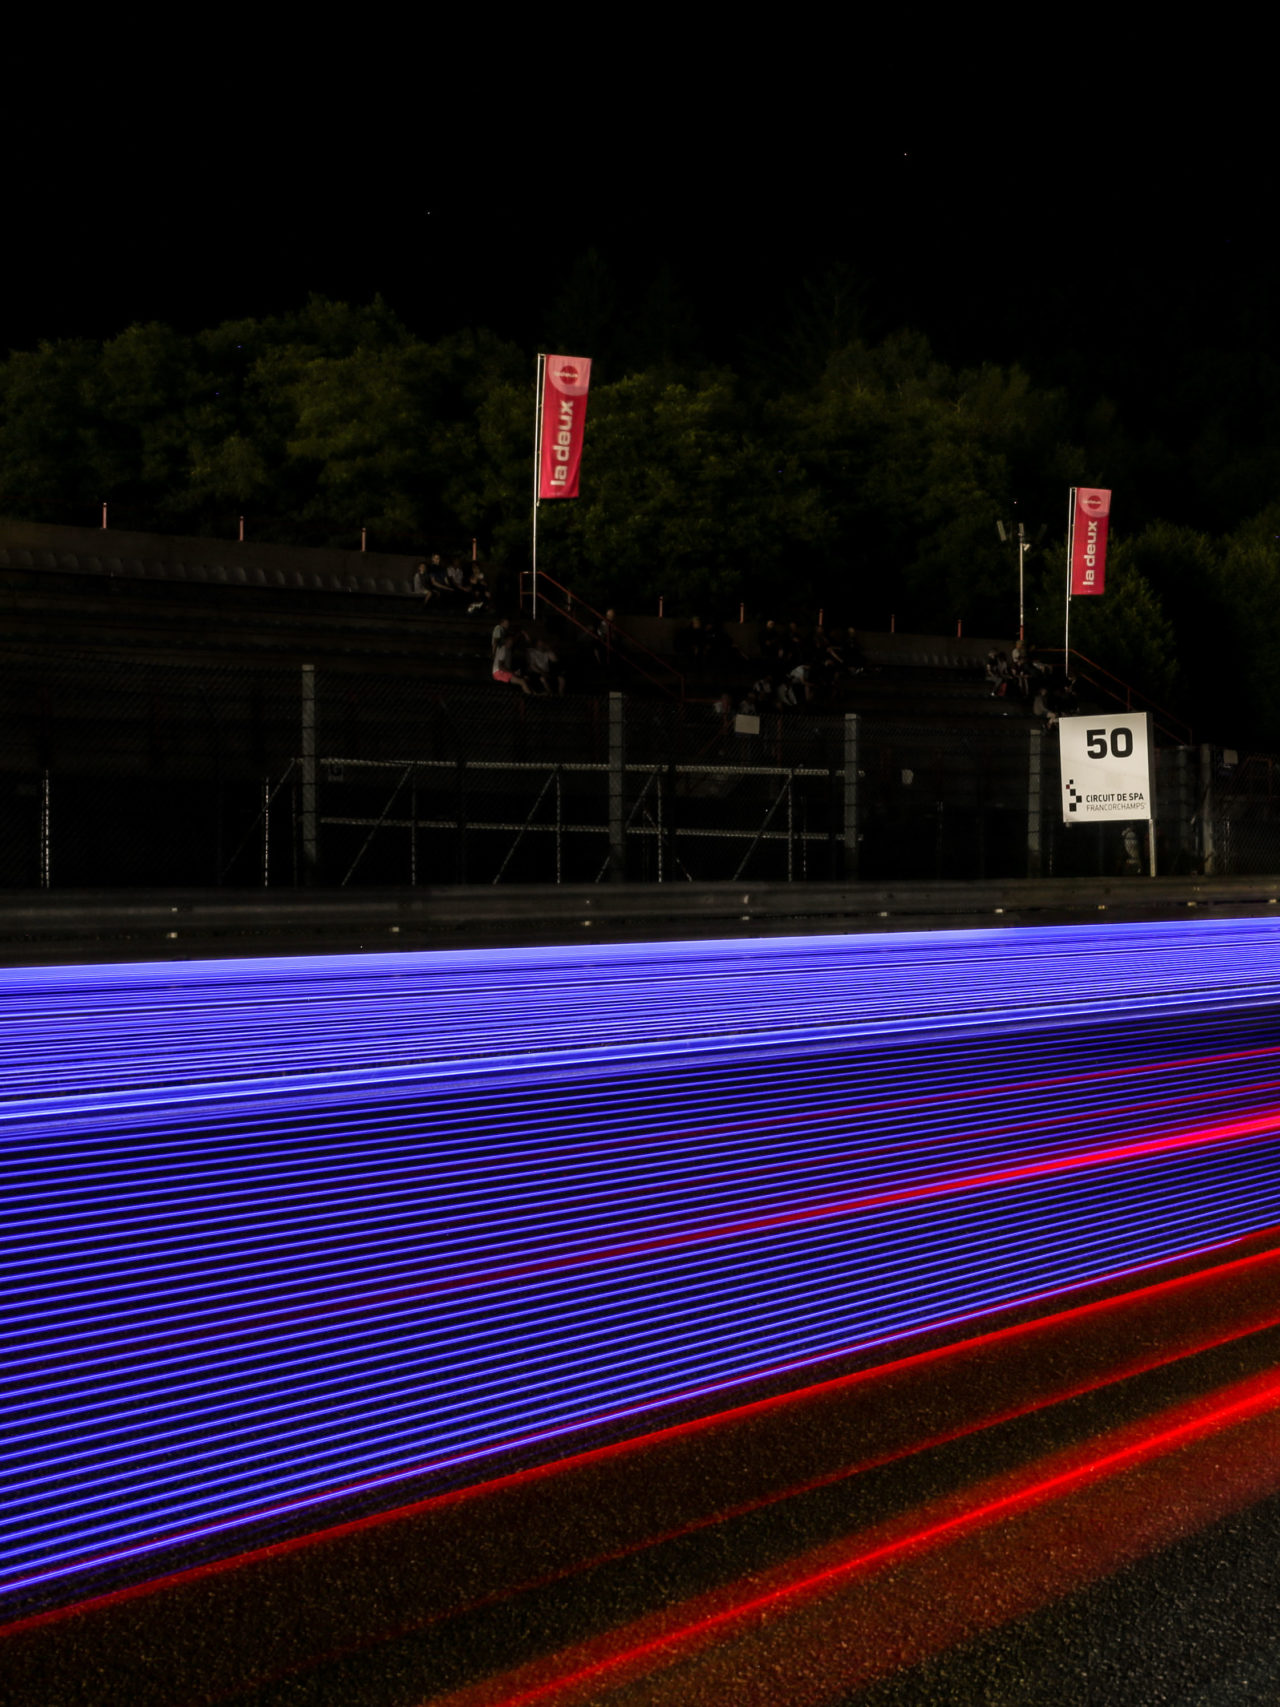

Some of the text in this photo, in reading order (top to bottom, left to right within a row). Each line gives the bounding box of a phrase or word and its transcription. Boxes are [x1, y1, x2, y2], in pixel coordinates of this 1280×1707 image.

[551, 400, 574, 486] la deux
[1082, 521, 1098, 586] la deux
[1086, 727, 1133, 759] 50
[1086, 792, 1144, 803] CIRCUIT DE SPA
[1086, 803, 1145, 812] FRANCORCHAMPS
